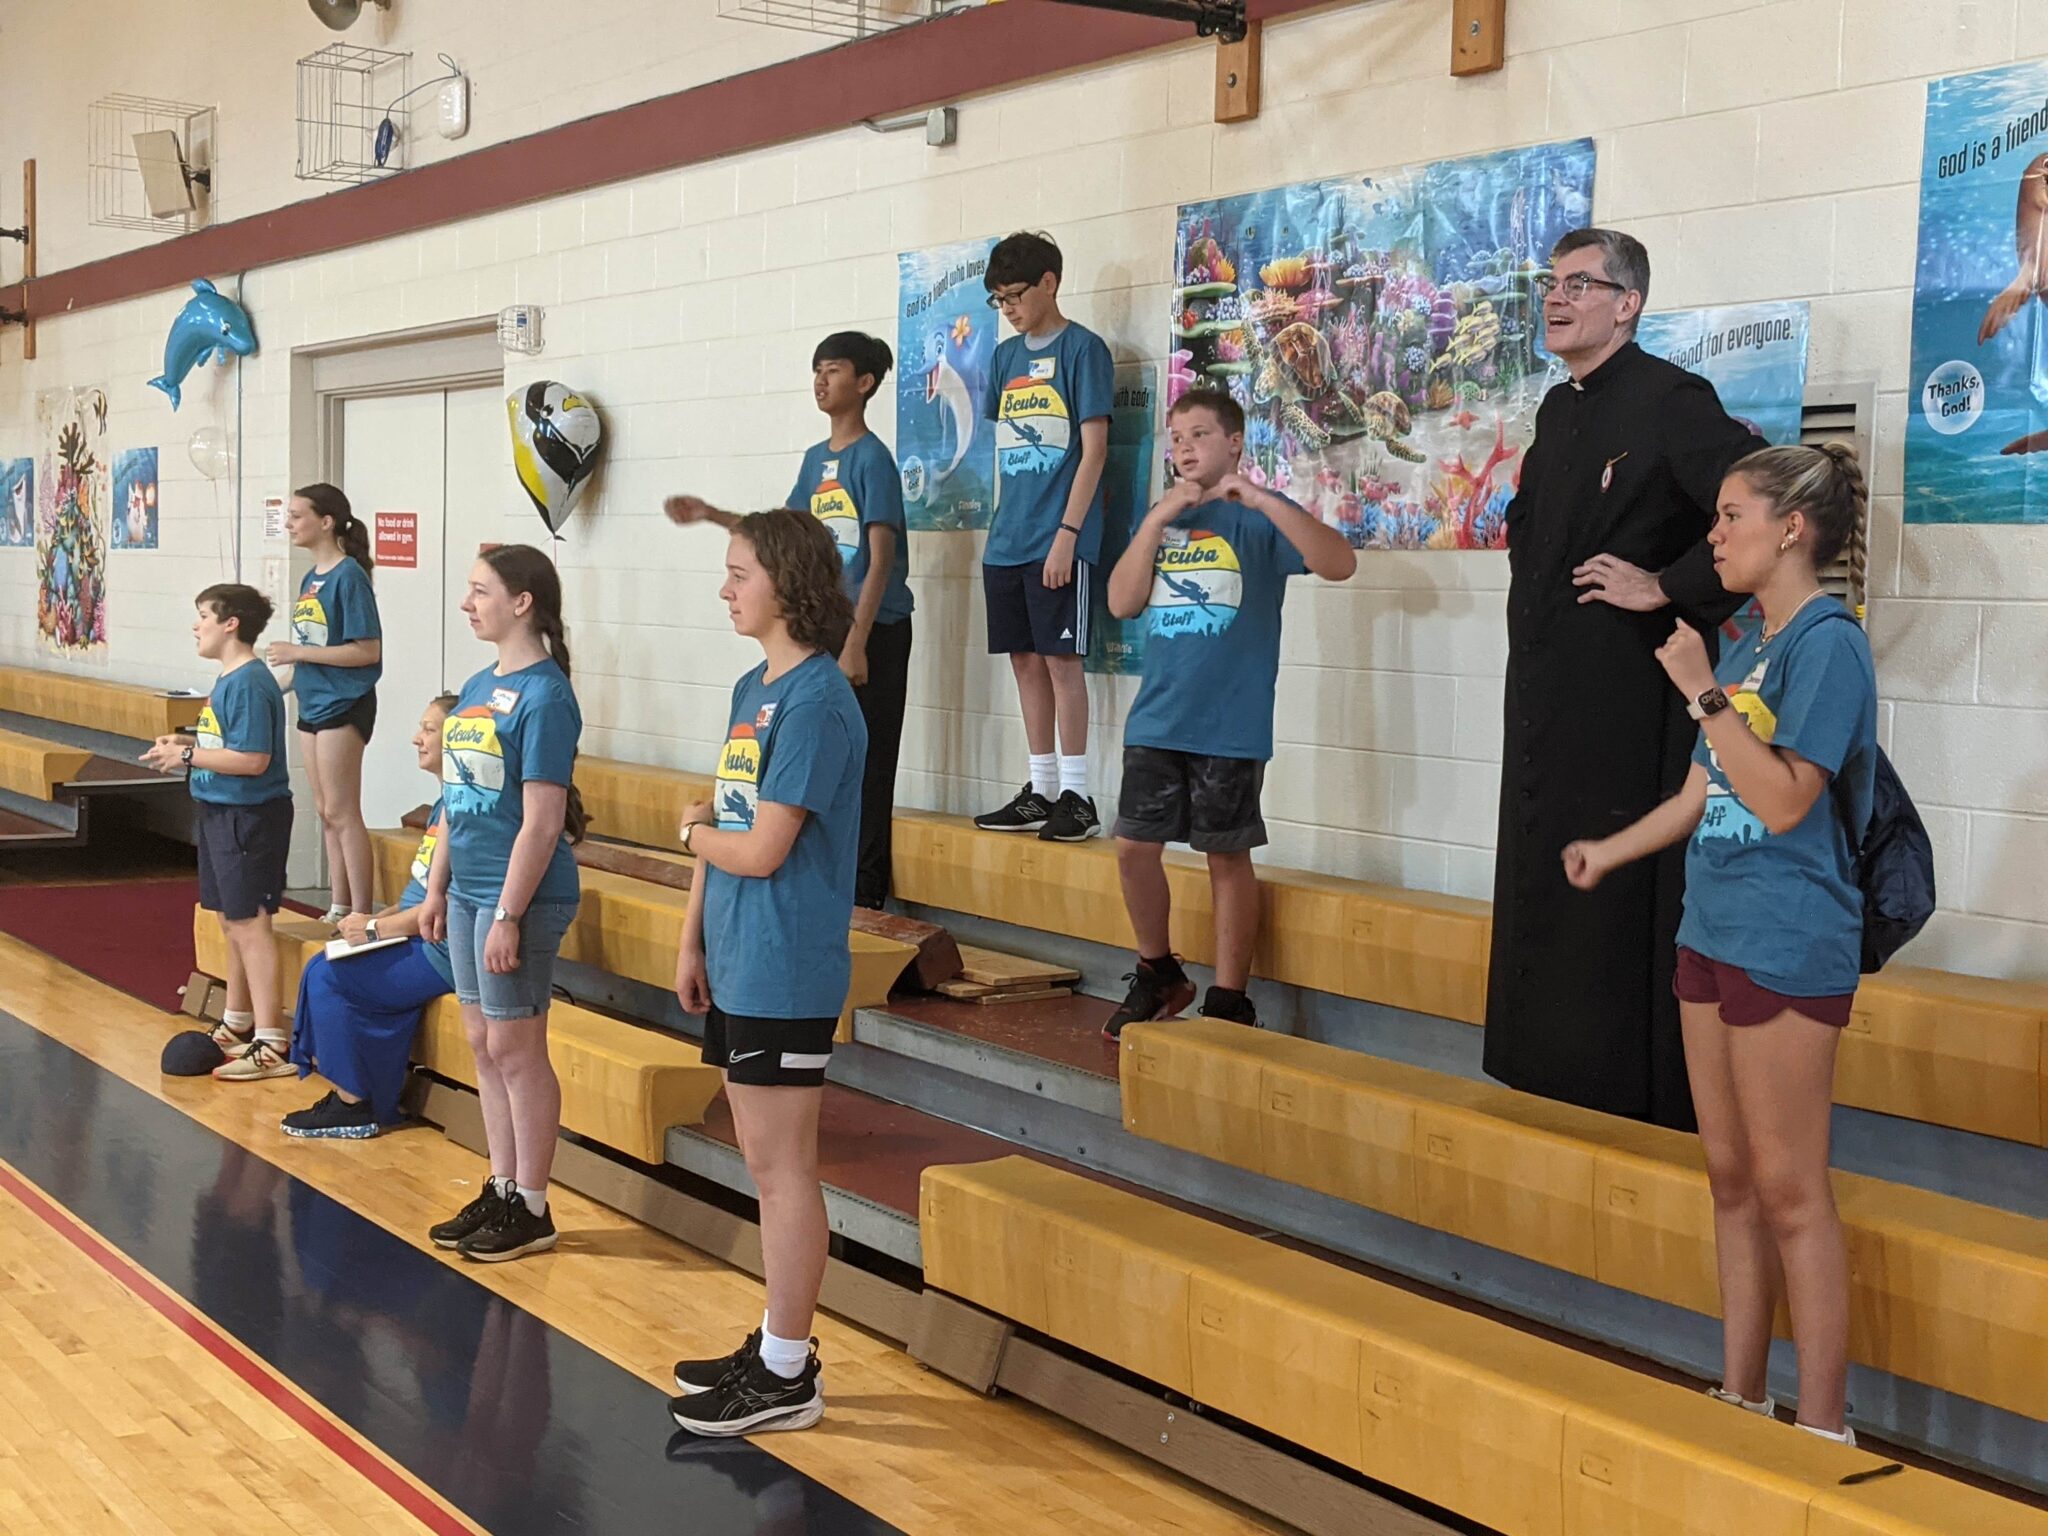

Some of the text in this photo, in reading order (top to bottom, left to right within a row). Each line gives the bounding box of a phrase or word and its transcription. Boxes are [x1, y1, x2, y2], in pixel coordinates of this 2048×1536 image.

[1938, 97, 2048, 179] God is a friend
[906, 295, 920, 318] God
[920, 295, 927, 312] is
[927, 291, 932, 307] a
[966, 259, 986, 279] loves
[1706, 331, 1724, 359] for
[1727, 317, 1795, 351] everyone.
[1131, 387, 1149, 408] God!
[1927, 374, 1980, 400] Thanks,
[1003, 392, 1051, 414] Scuba
[1941, 394, 1971, 418] God!
[1007, 450, 1031, 467] Staff
[1161, 611, 1195, 627] Staff
[446, 721, 486, 744] Scuba
